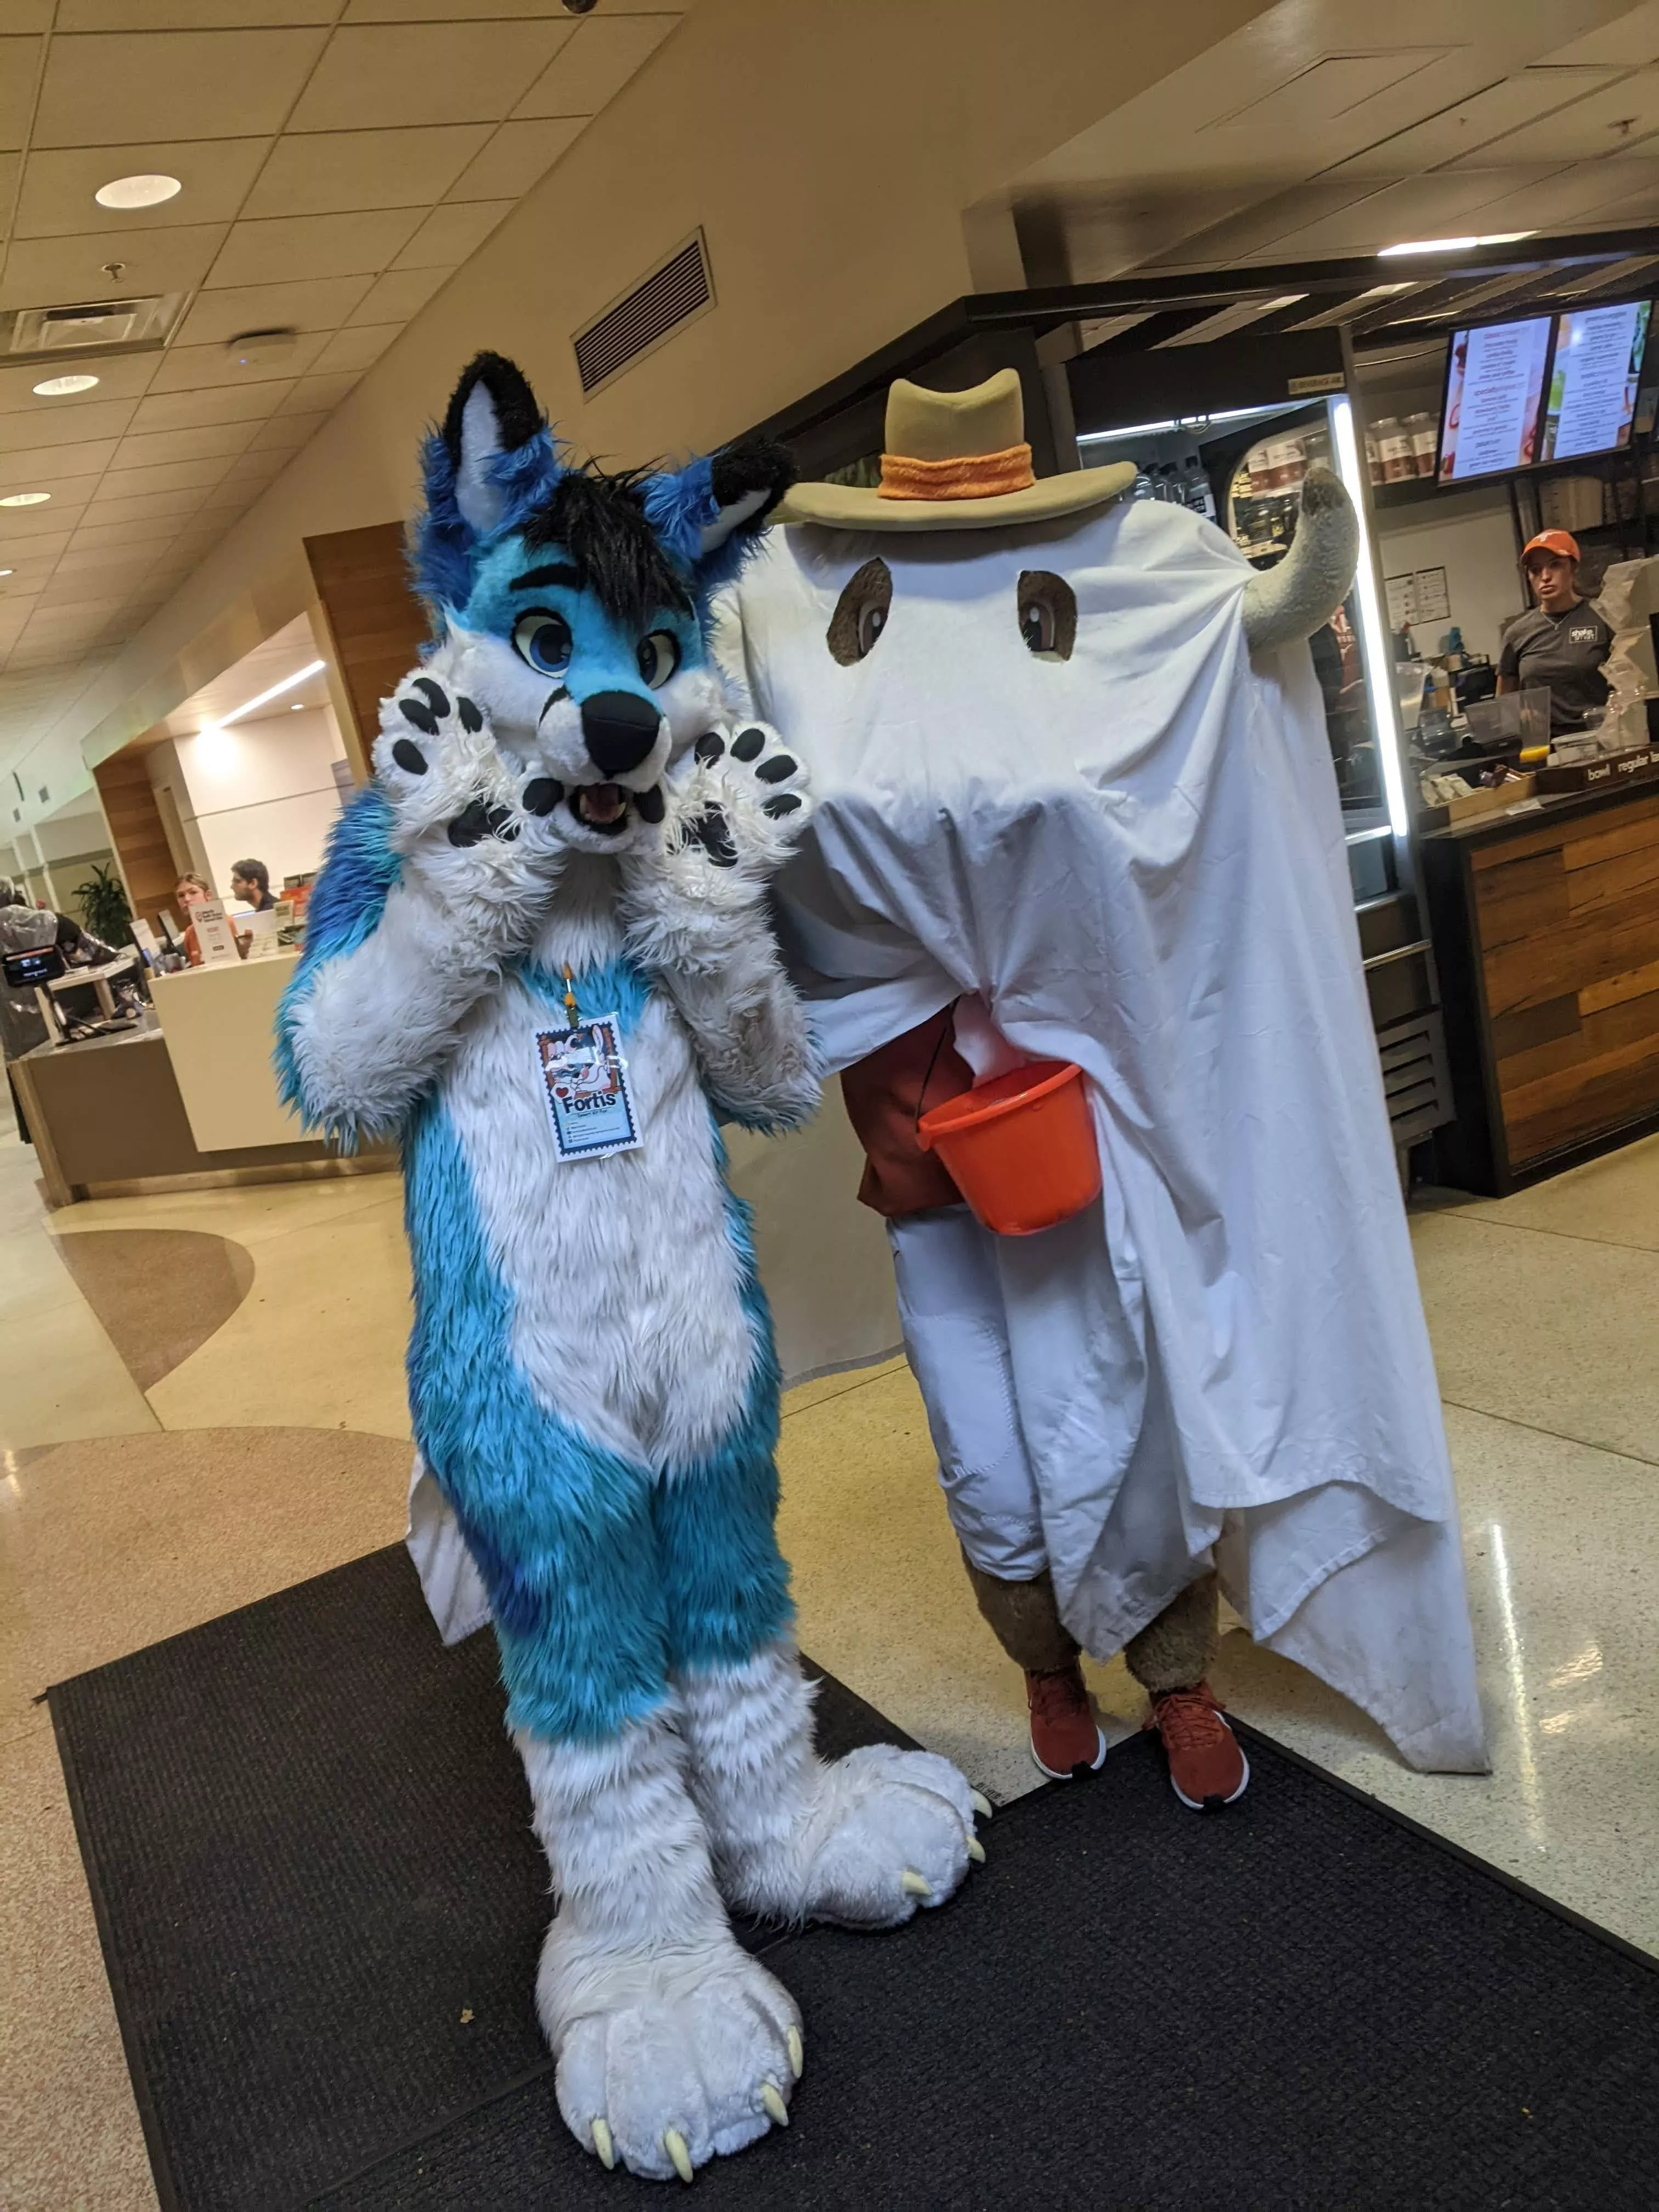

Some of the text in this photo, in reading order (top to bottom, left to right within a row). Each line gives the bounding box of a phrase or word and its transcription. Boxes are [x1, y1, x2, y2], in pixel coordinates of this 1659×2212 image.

[1588, 763, 1610, 781] bowl
[1618, 755, 1649, 773] regular
[562, 1091, 616, 1114] Fortis
